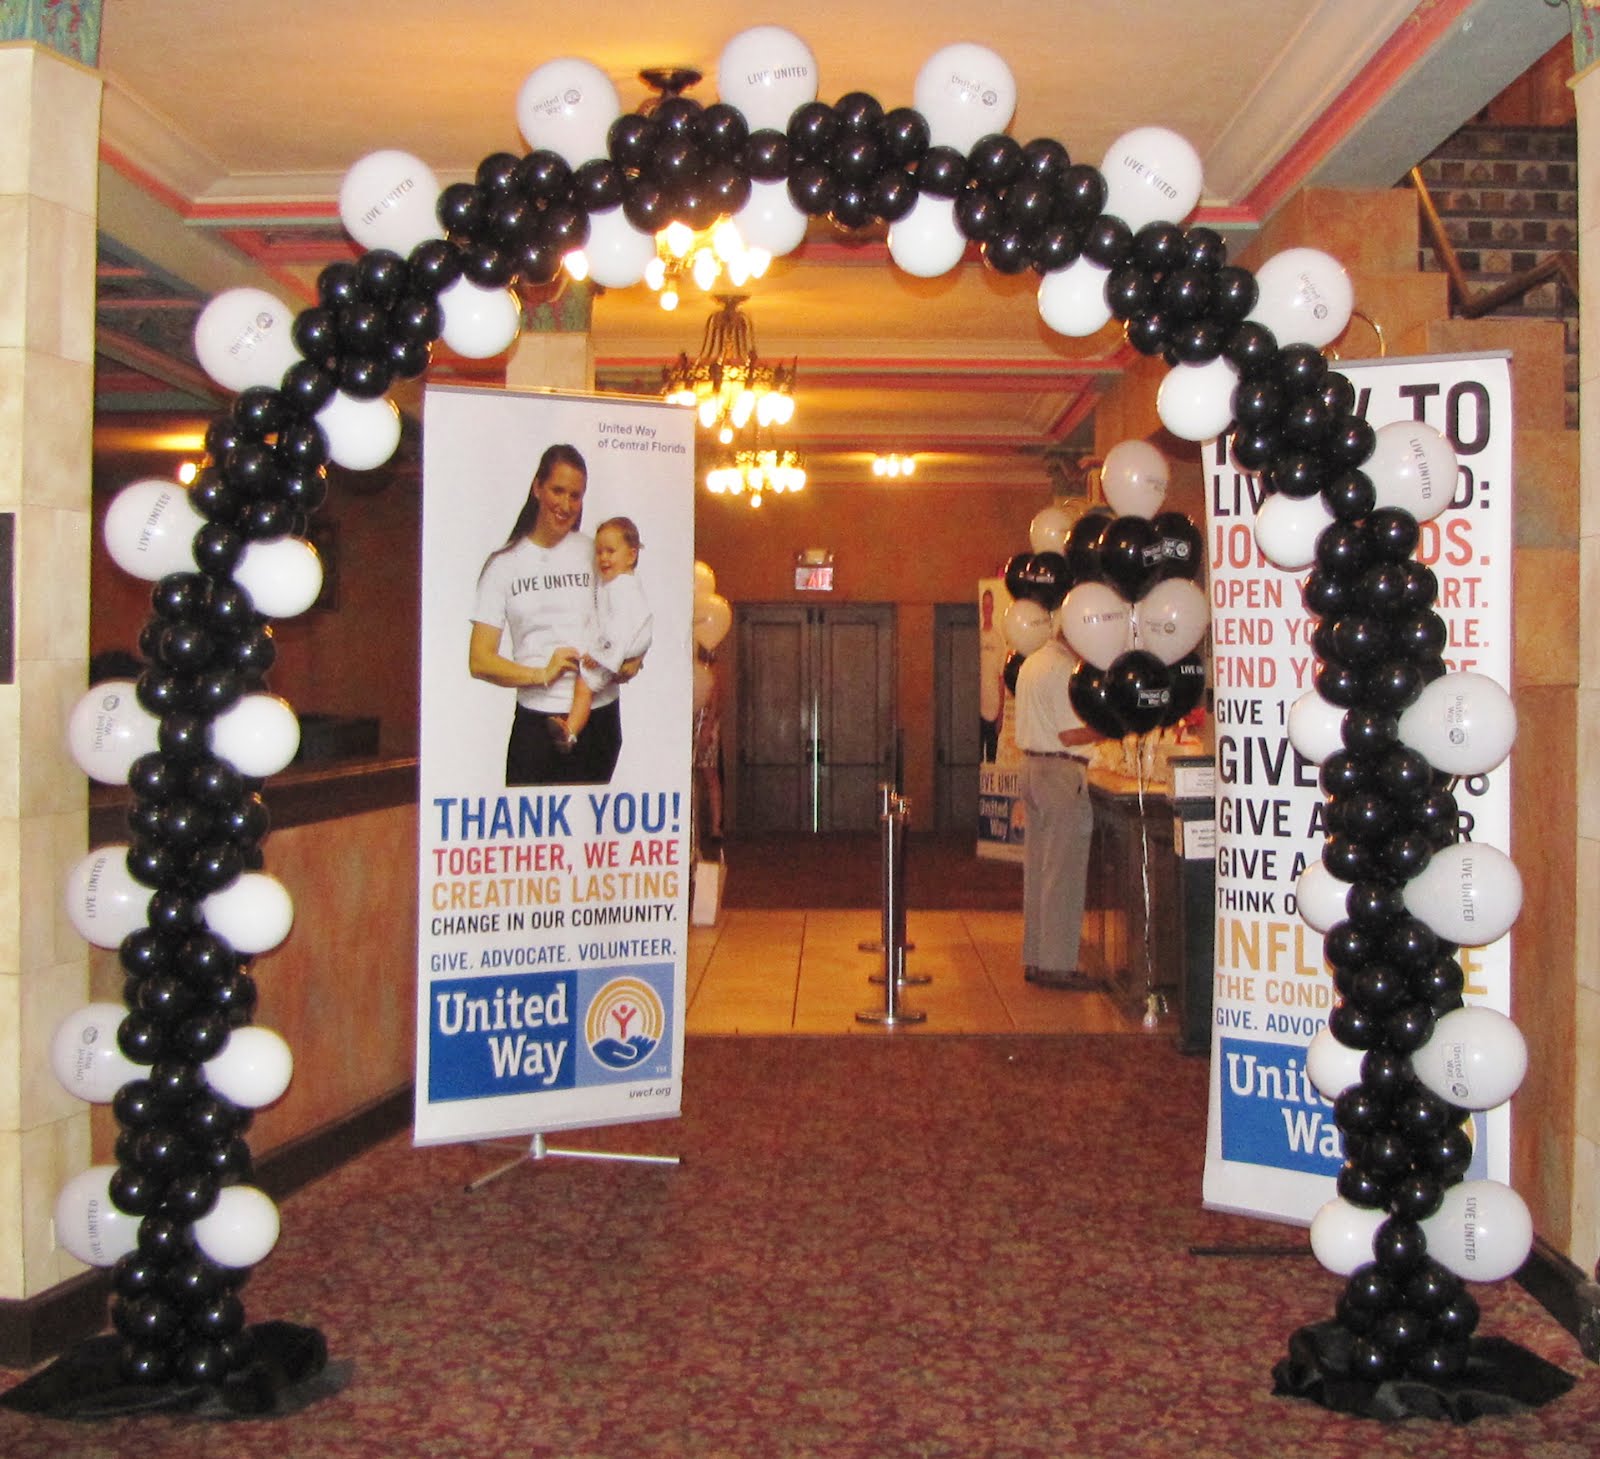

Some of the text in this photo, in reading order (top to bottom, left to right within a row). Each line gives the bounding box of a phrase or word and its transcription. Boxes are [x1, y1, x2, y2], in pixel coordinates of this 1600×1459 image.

[747, 66, 809, 85] LIVE UNITED
[1123, 155, 1144, 175] LIVE
[362, 206, 380, 226] LIVE
[598, 422, 657, 439] United Way
[598, 438, 687, 454] of Central Florida
[1409, 438, 1432, 500] LIVE UNITED
[1213, 474, 1265, 517] LIV
[137, 492, 171, 552] LIVE UNITED
[511, 572, 590, 596] LIVE UNITED
[1214, 578, 1282, 609] OPEN
[1214, 618, 1274, 646] LEND
[1180, 665, 1195, 675] LIVE
[1214, 656, 1277, 689] FIND
[1217, 699, 1263, 725] GIVE
[433, 791, 681, 841] THANK YOU!
[1219, 798, 1292, 837] GIVE
[432, 839, 680, 876] TOGETHER, WE ARE
[1218, 847, 1278, 881] GIVE
[1460, 857, 1473, 885] LIVE
[85, 857, 108, 918] LIVE UNITED
[431, 871, 680, 911] CREATING LASTING
[1218, 886, 1276, 914] THINK
[1462, 886, 1476, 922] UNITED
[431, 904, 678, 936] CHANGE IN OUR COMMUNITY.
[430, 937, 678, 972] GIVE. ADVOCATE. VOLUNTEER.
[1215, 973, 1256, 1002] THE
[436, 981, 569, 1035] United
[1216, 1007, 1258, 1031] GIVE.
[488, 1034, 568, 1085] Way
[629, 1086, 672, 1098] uwcf.org
[1226, 1052, 1335, 1108] Unit
[1281, 1107, 1343, 1159] Wa
[1465, 1197, 1477, 1261] LIVE UNITED
